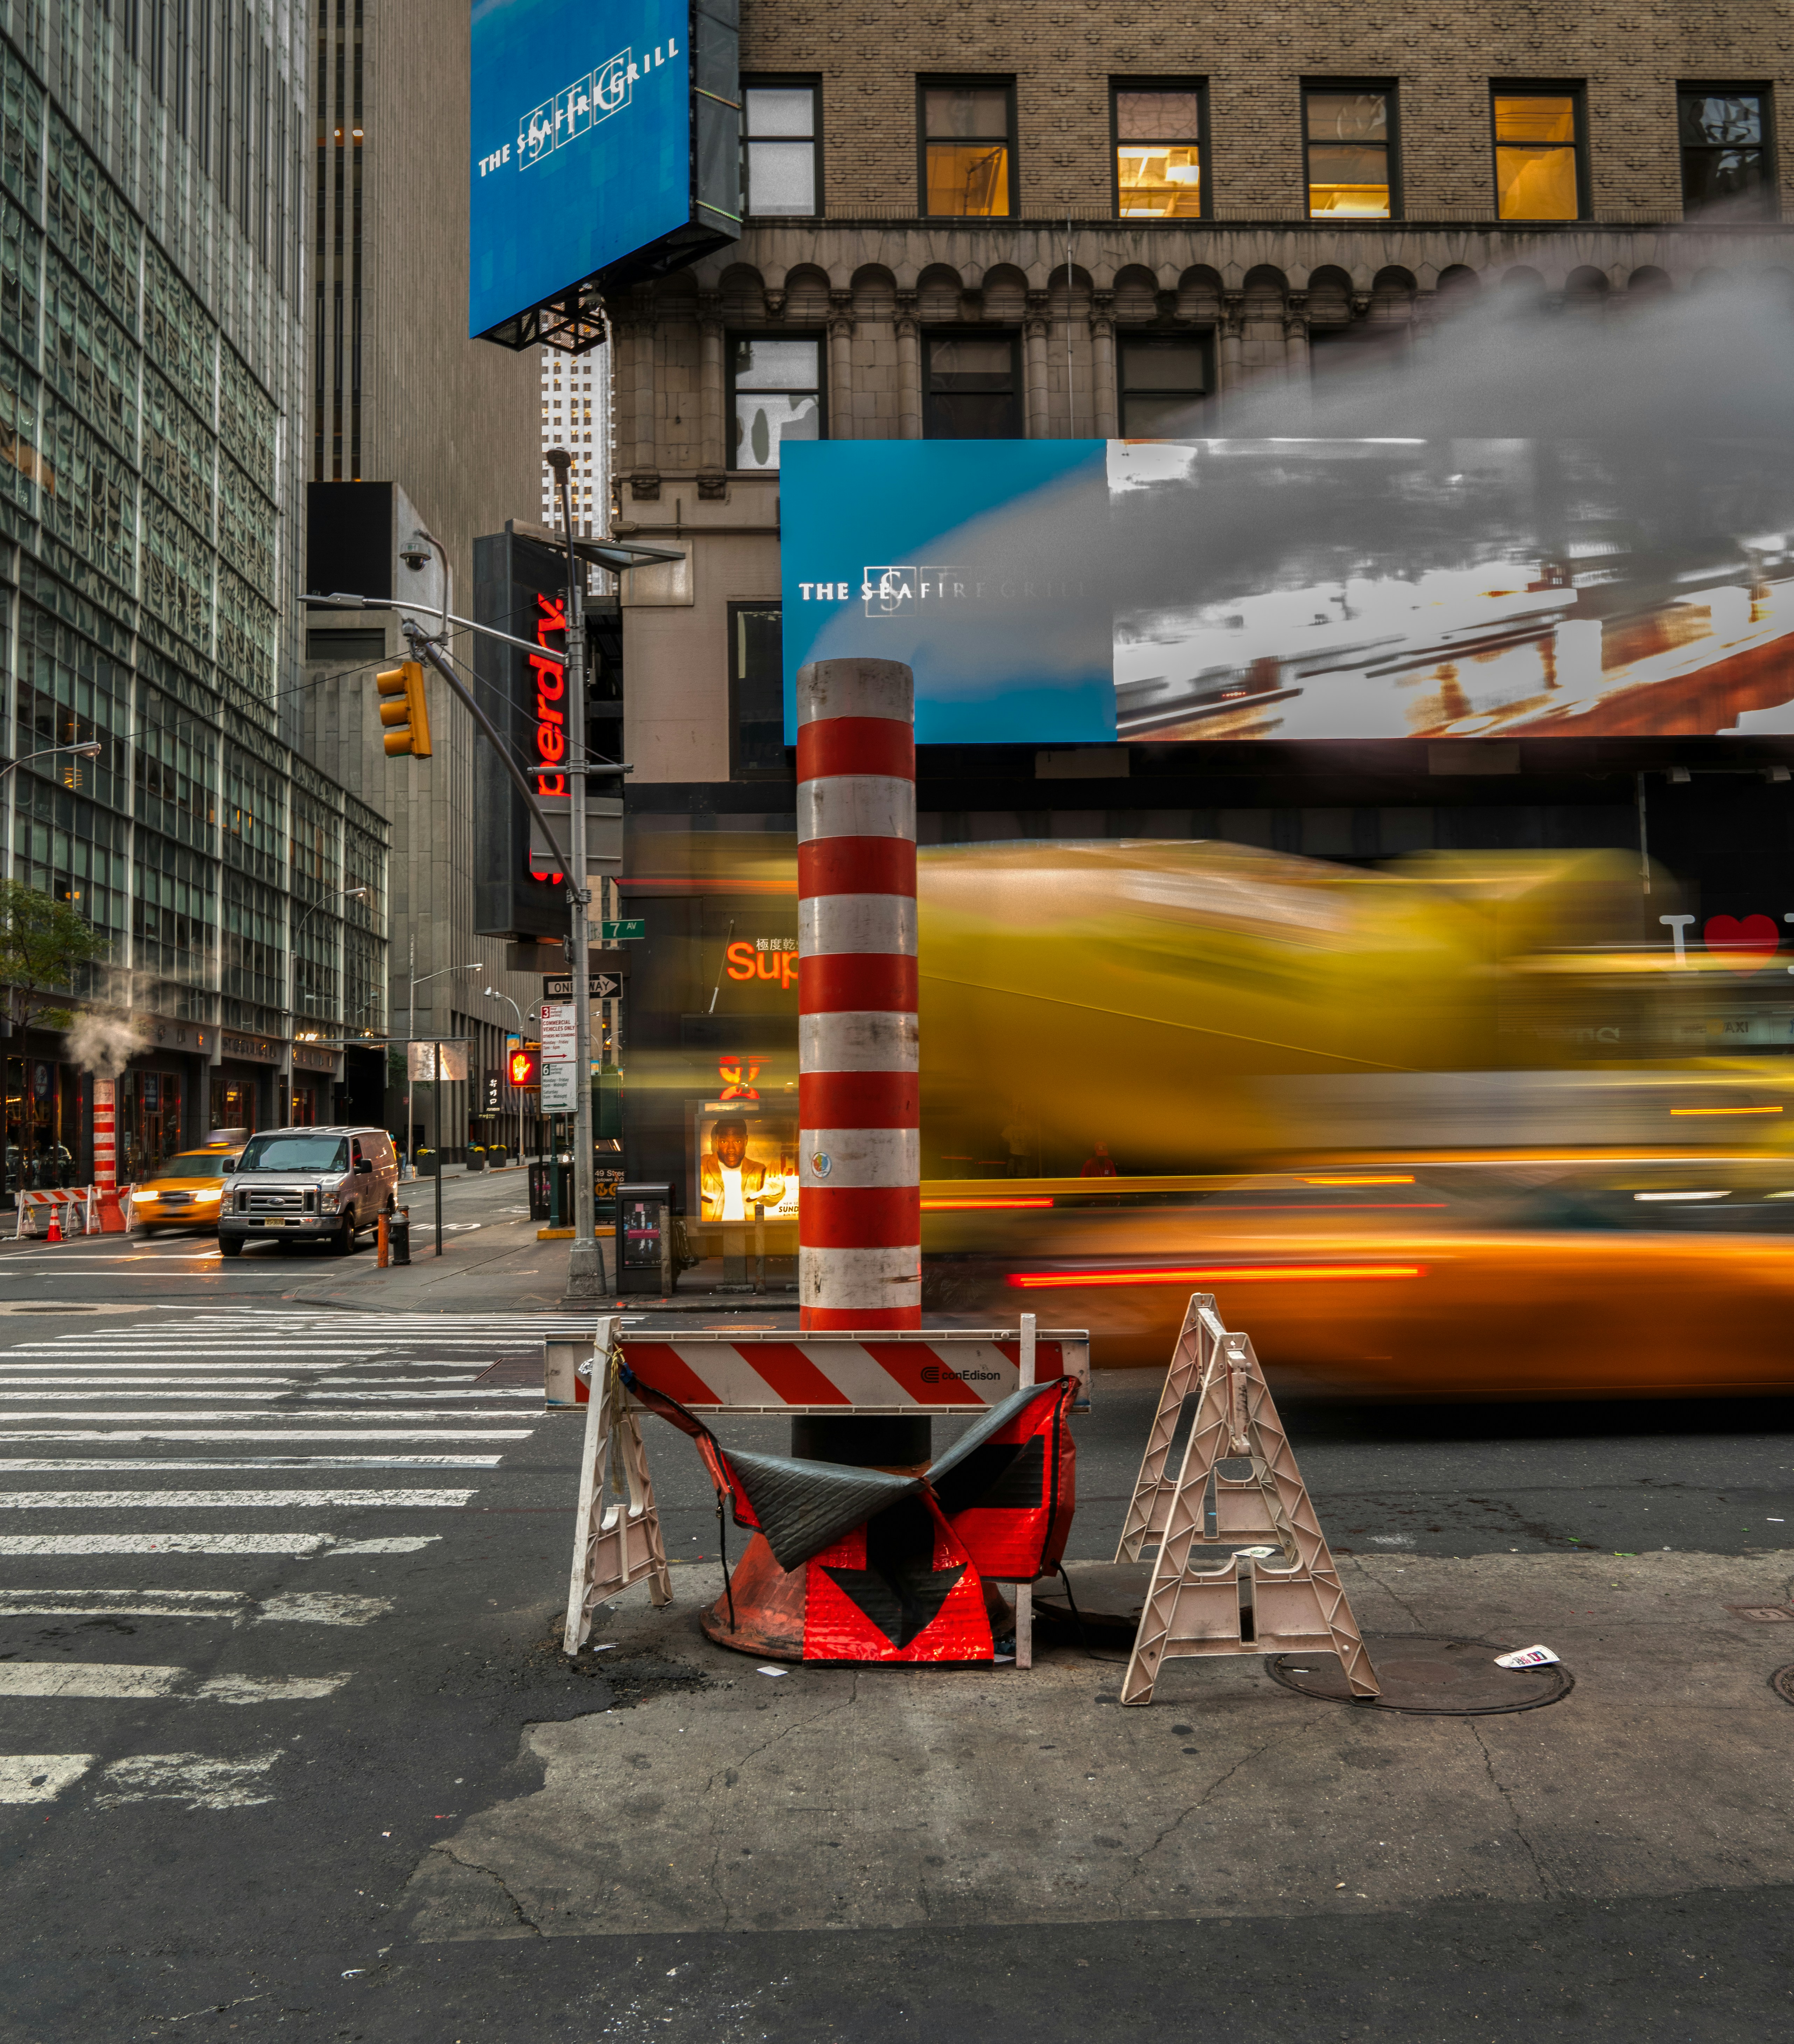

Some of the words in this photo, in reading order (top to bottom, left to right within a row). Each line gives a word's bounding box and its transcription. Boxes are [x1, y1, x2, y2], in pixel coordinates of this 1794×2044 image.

[479, 144, 510, 176] THE
[611, 38, 679, 93] GRILL
[799, 583, 849, 600] THE
[861, 582, 985, 600] SEAFIRE
[609, 923, 620, 937] 7
[626, 922, 637, 930] AV
[756, 938, 798, 951] 極度乾
[727, 941, 798, 989] Sup
[589, 980, 610, 992] WAY
[543, 1008, 549, 1018] 3
[543, 1064, 549, 1075] 6
[942, 1370, 1000, 1381] conEdison
